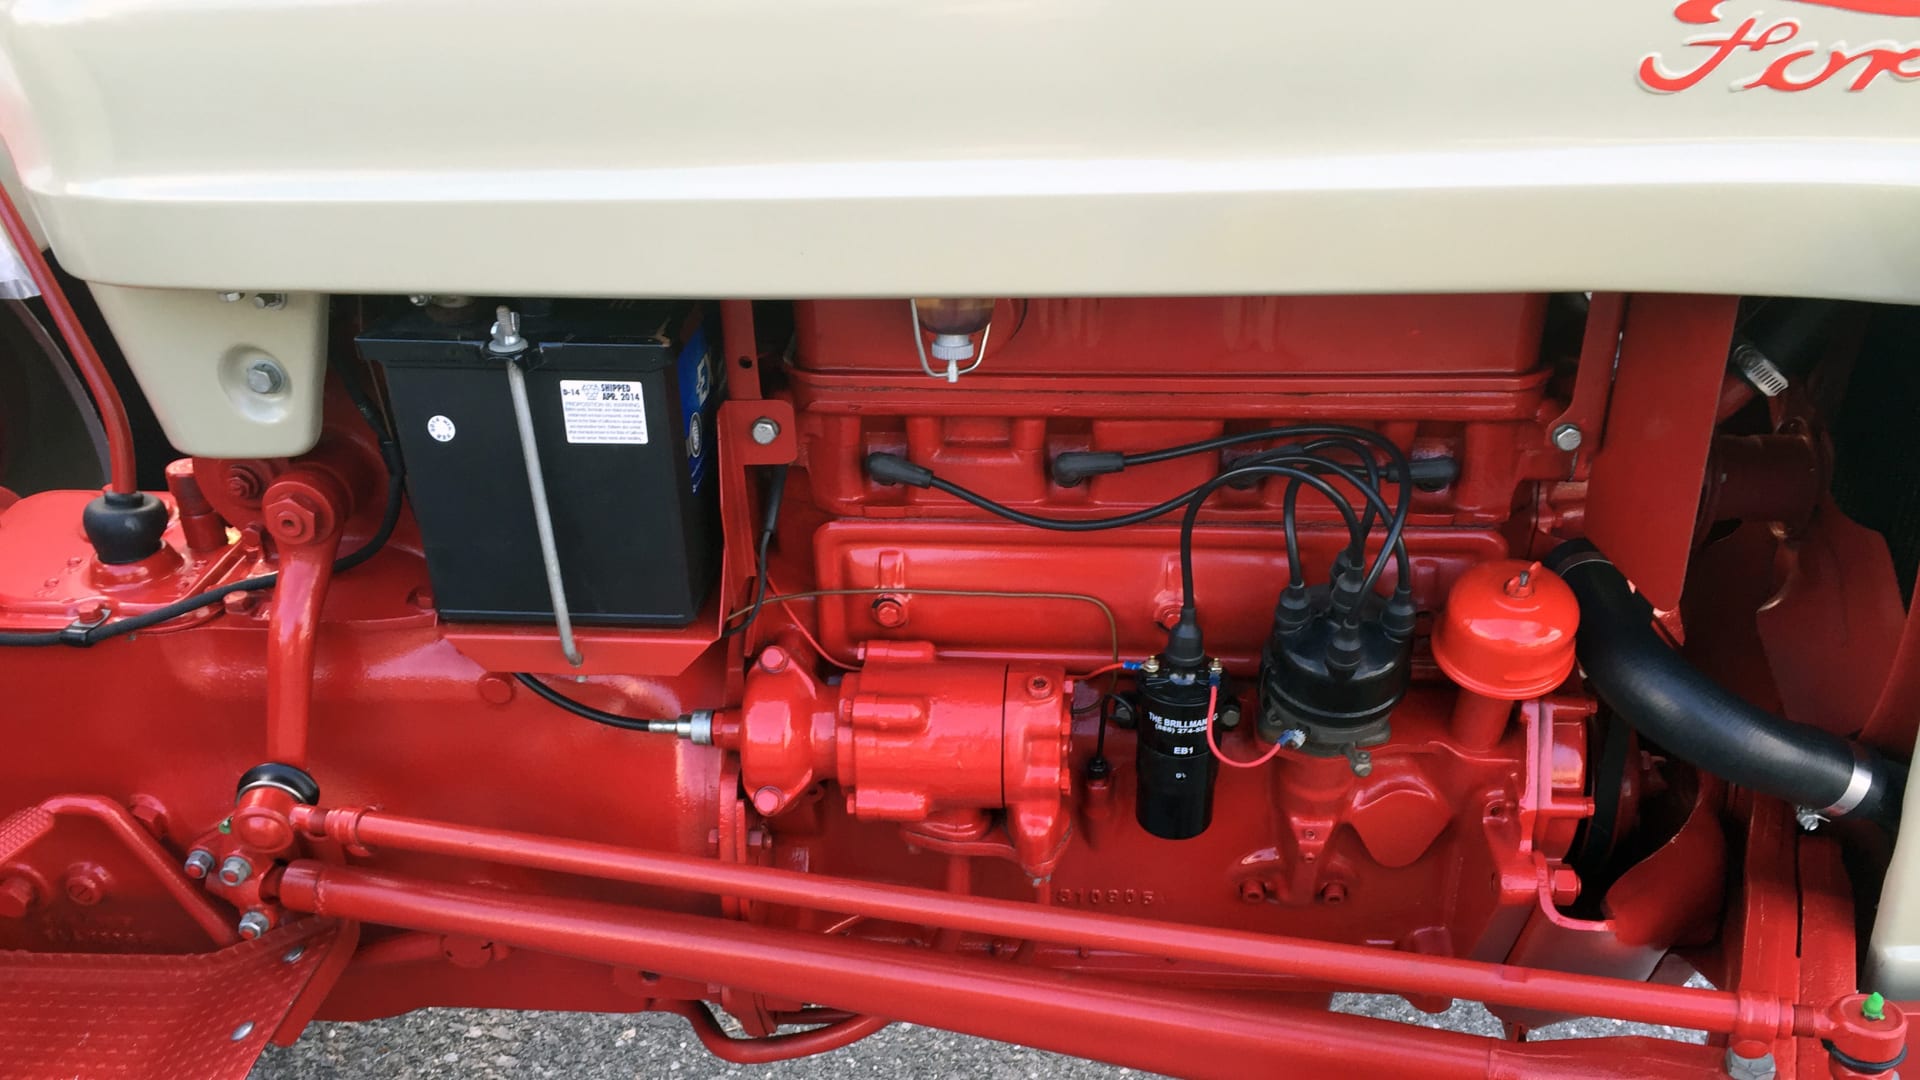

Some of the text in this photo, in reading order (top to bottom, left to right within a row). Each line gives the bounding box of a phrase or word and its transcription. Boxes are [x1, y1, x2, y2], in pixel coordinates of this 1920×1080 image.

[601, 383, 631, 393] SHIPPED
[602, 393, 641, 401] APR. 2014
[1148, 711, 1163, 725] THE
[1173, 746, 1194, 755] EB1
